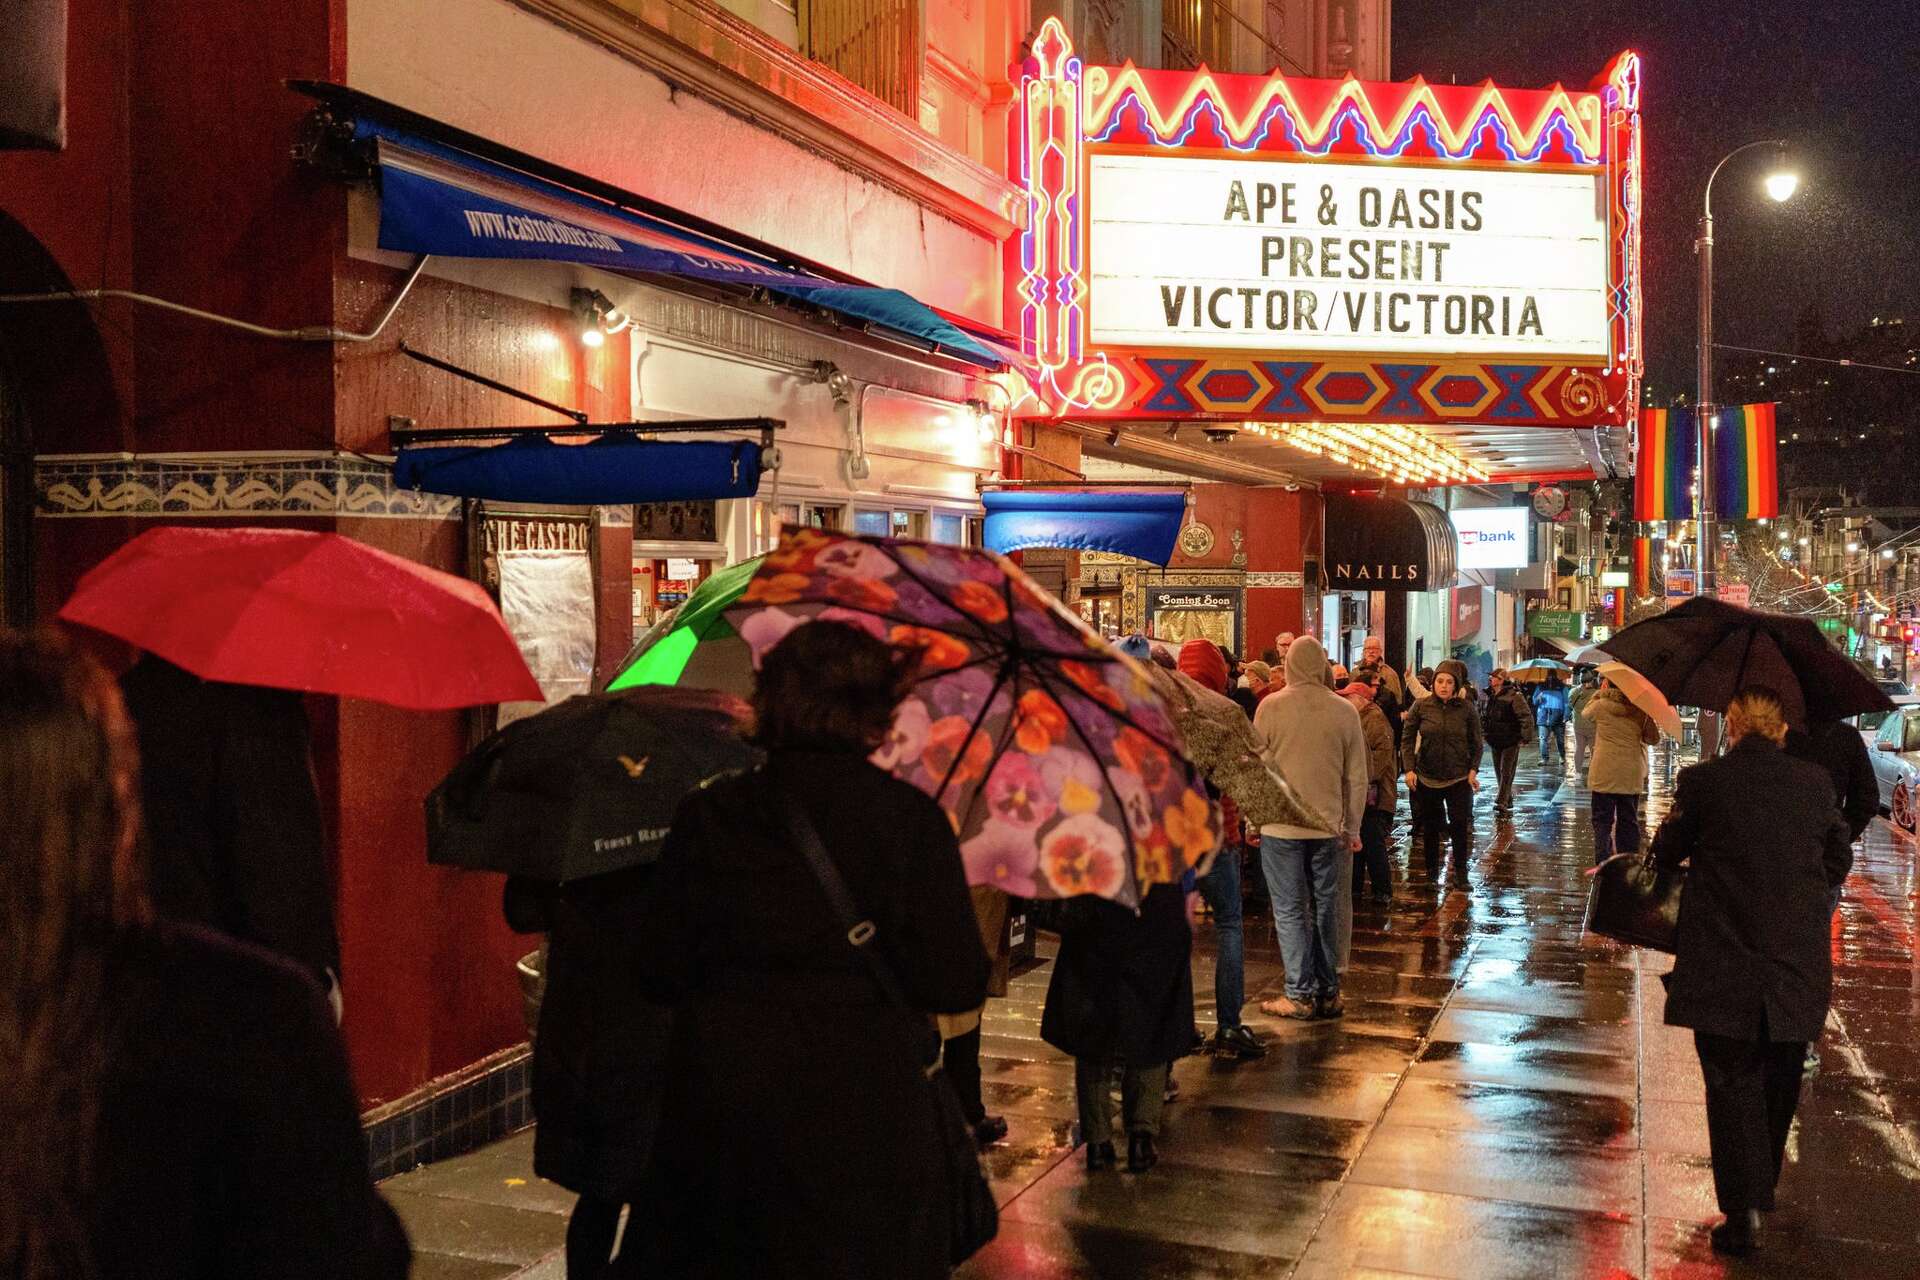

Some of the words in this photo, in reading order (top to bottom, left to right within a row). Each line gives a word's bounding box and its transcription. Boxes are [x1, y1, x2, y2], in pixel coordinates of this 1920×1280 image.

[1223, 180, 1297, 224] APE
[1317, 184, 1338, 225] &
[1359, 187, 1482, 231] OASIS
[1261, 236, 1450, 282] PRESENT
[1160, 285, 1544, 336] VICTOR/VICTORIA
[483, 520, 520, 551] THE
[526, 521, 587, 551] CASTRO
[1479, 530, 1516, 542] bank
[1337, 564, 1418, 580] NAILS
[1158, 594, 1201, 607] Coming
[1204, 594, 1230, 605] Soon
